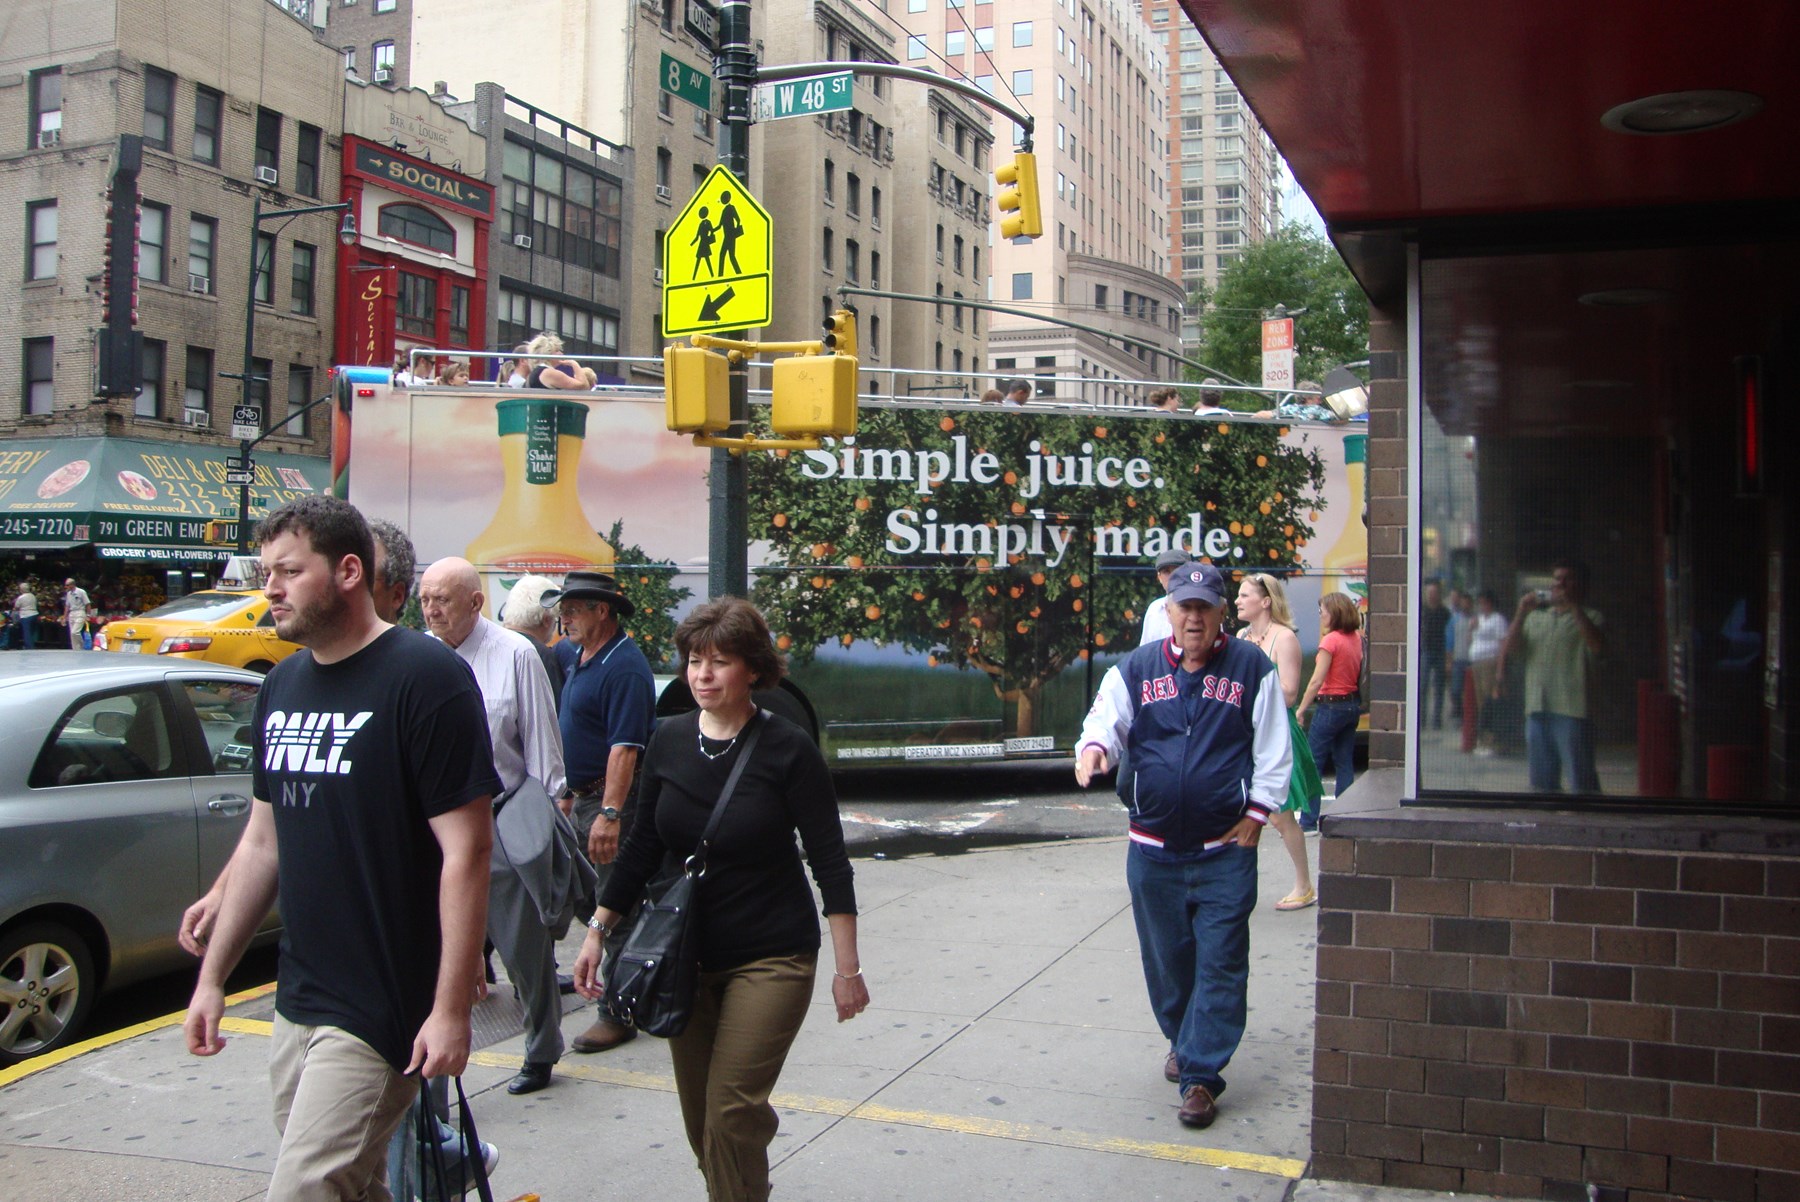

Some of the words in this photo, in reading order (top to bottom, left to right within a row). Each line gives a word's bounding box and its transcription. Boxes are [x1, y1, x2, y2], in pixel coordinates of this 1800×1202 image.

[693, 5, 712, 37] ONE
[668, 61, 681, 92] 8
[689, 71, 703, 89] AV
[779, 85, 795, 114] W
[801, 80, 825, 110] 48
[832, 77, 848, 93] ST
[389, 112, 405, 129] BAR
[418, 124, 449, 146] LOUNGE
[388, 161, 464, 200] SOCIAL
[1269, 323, 1286, 333] RED
[1267, 336, 1289, 347] ZONE
[1266, 370, 1289, 381] $205
[0, 450, 51, 474] ERY
[528, 449, 554, 461] Shake
[141, 454, 191, 481] DELI
[185, 457, 209, 483] &
[530, 461, 552, 473] Well
[801, 435, 999, 495] Simple
[1020, 440, 1164, 498] juice.
[103, 502, 131, 511] FREE
[132, 504, 180, 513] DELIVERY
[100, 521, 118, 536] 791
[126, 519, 173, 537] GREEN
[885, 508, 1075, 568] Simply
[1094, 512, 1243, 558] made.
[102, 547, 146, 558] GROCERY
[150, 549, 171, 559] DELI
[174, 550, 213, 560] FLOWERS
[506, 561, 571, 569] ORIGINAL
[1141, 673, 1179, 706] RED
[1202, 674, 1246, 708] SOX
[906, 746, 942, 759] OPERATOR
[962, 745, 976, 757] NYS
[977, 745, 991, 756] DOT
[1008, 739, 1030, 750] USDOT
[282, 780, 317, 808] NY
